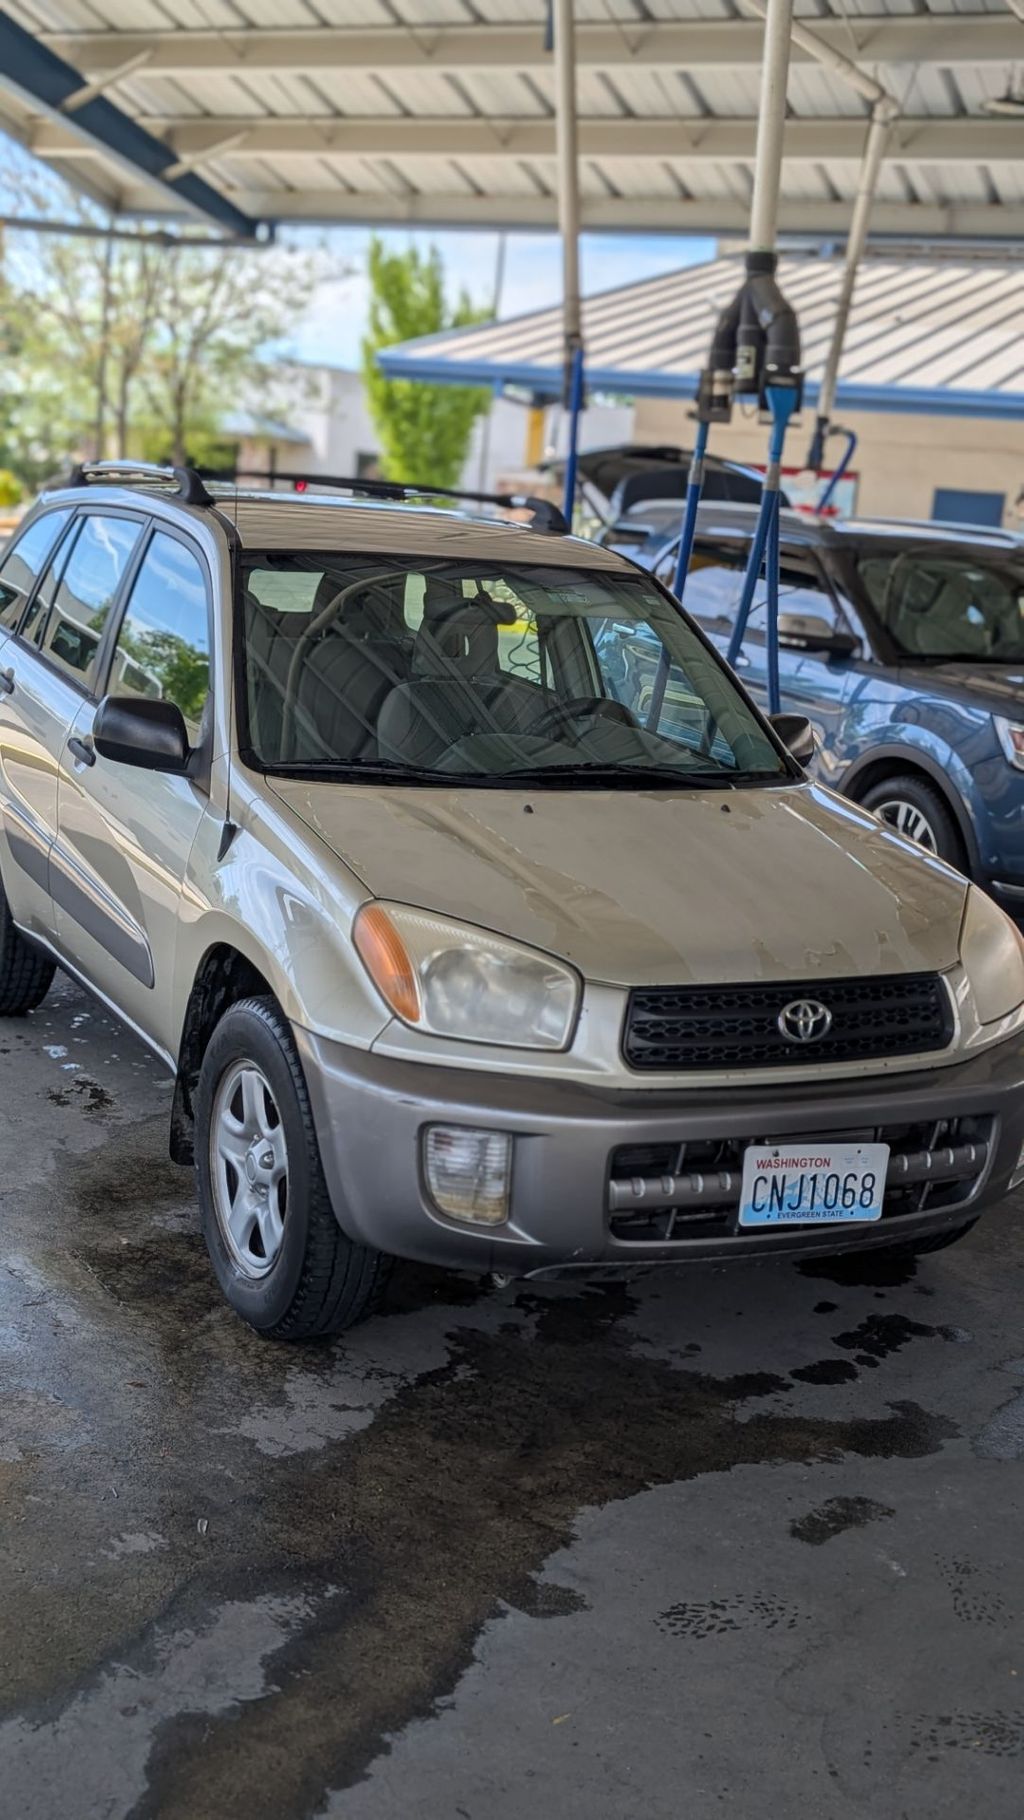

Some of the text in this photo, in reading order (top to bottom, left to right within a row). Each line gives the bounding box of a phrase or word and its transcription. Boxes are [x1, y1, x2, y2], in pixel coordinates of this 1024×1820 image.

[756, 1157, 831, 1169] WASHINGTON
[752, 1173, 876, 1212] CNJ1068
[777, 1210, 844, 1219] EVERGREEN STATE
